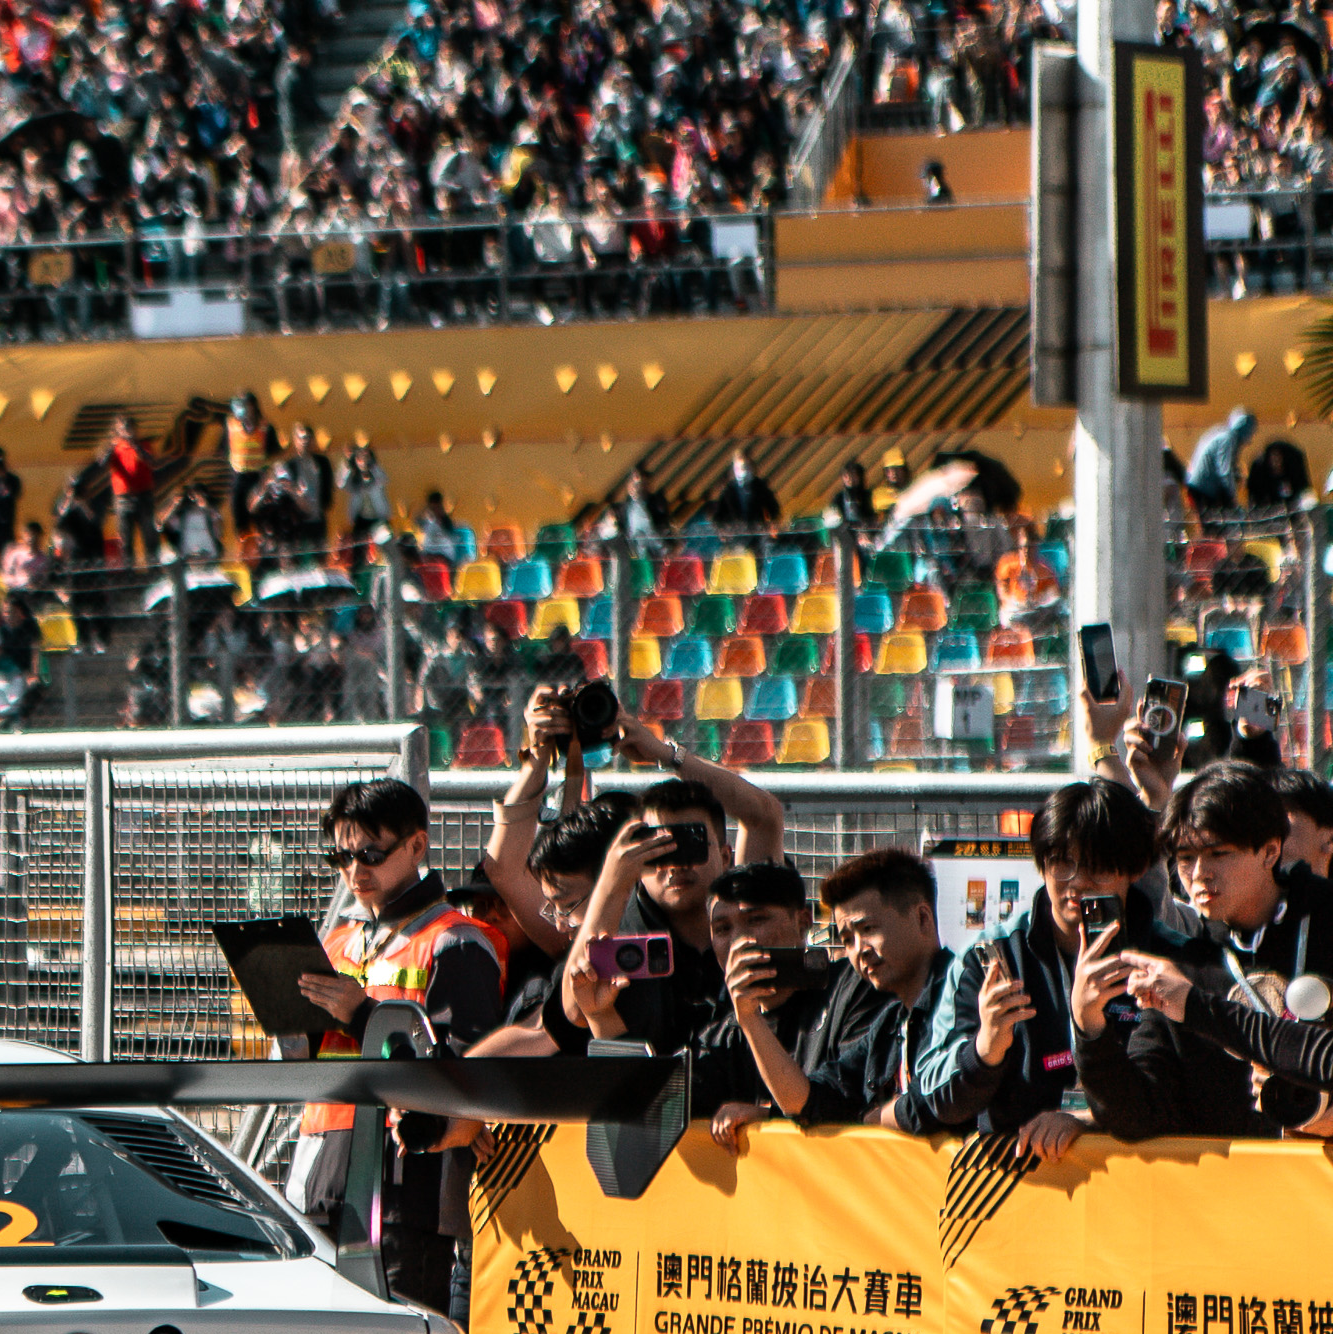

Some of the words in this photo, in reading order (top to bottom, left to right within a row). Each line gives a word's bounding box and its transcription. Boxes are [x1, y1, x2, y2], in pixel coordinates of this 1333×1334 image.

[1143, 88, 1177, 359] PIRELLI
[573, 1248, 622, 1268] GRAND
[572, 1269, 605, 1289] PRIX
[571, 1291, 619, 1312] MACAU
[1064, 1286, 1123, 1309] GRAND
[1062, 1310, 1102, 1331] PRIX
